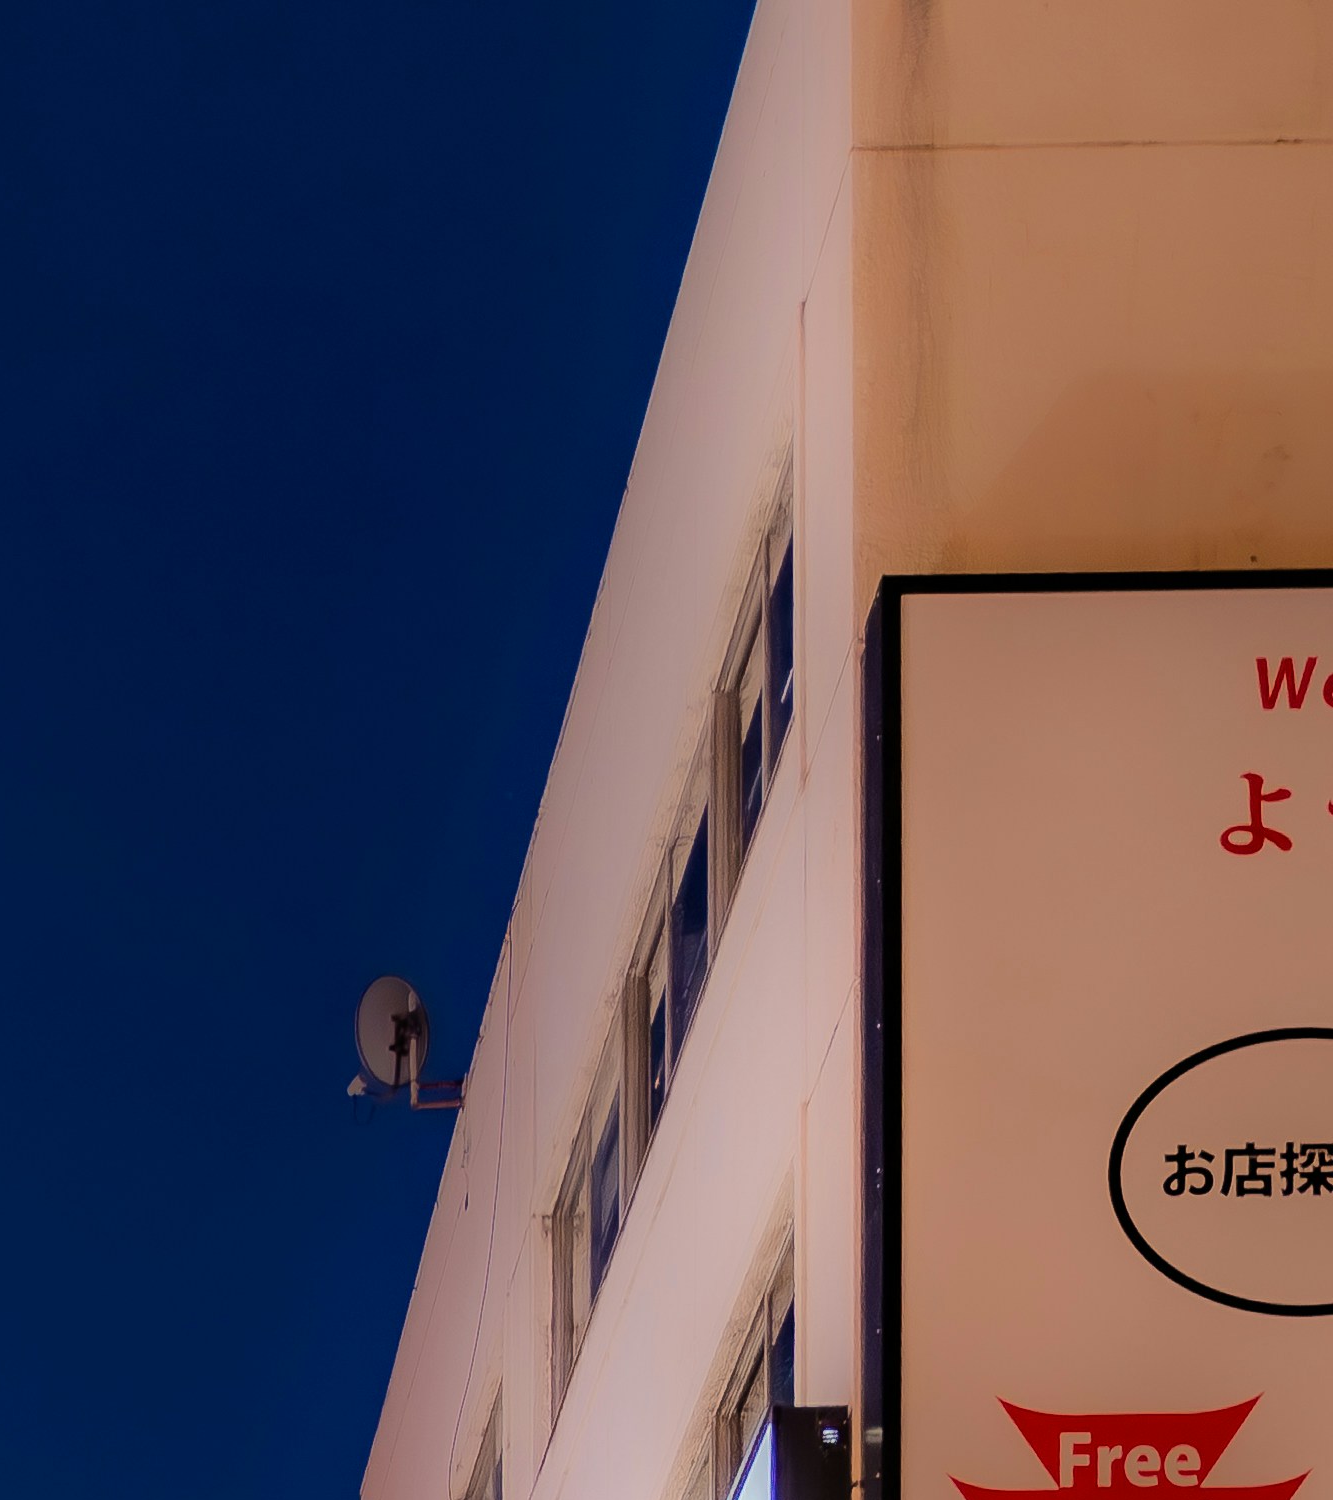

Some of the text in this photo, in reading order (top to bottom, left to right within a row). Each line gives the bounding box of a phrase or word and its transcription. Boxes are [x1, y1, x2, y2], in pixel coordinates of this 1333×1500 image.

[1255, 656, 1333, 712] W
[1220, 772, 1333, 856] よ
[1162, 1143, 1333, 1199] お店探
[1058, 1430, 1202, 1491] Free
